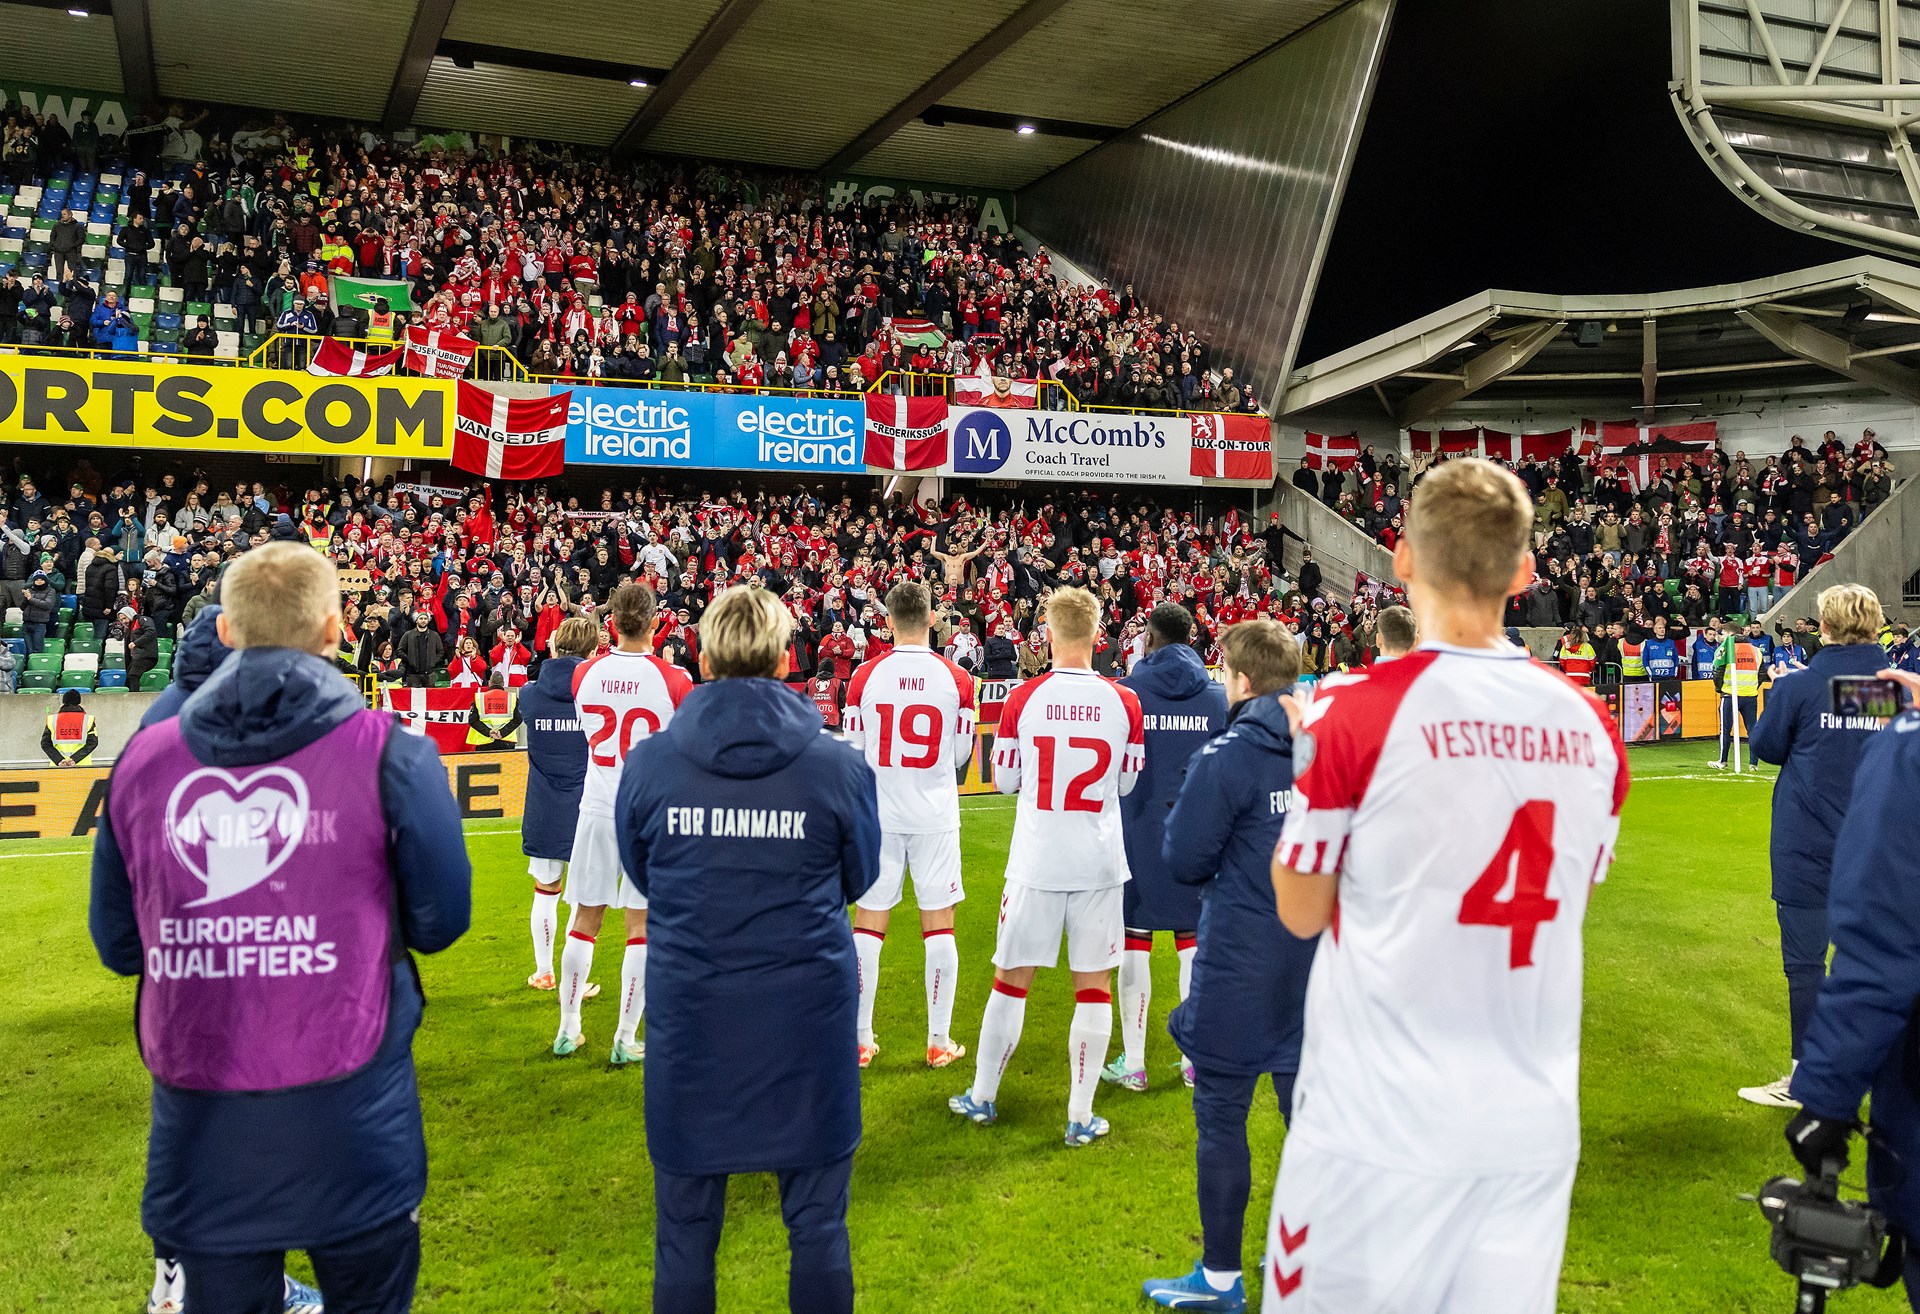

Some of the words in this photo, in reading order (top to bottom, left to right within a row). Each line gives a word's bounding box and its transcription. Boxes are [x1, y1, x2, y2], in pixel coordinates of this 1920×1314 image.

[0, 88, 128, 138] WA
[0, 368, 443, 448] RTS.COM
[567, 397, 689, 427] electric
[737, 405, 854, 436] electric
[457, 416, 549, 444] VANGEDE
[585, 424, 690, 459] Ireland
[966, 427, 1001, 460] M
[1025, 417, 1166, 449] McComb's
[1191, 437, 1270, 451] LUX-ON-TOUR
[758, 432, 855, 465] Ireland
[1026, 451, 1066, 465] Coach
[1070, 452, 1110, 467] Travel
[441, 489, 463, 497] THOMA
[899, 677, 925, 691] WIND
[1655, 668, 1669, 676] 973
[601, 680, 640, 695] YURARY
[535, 719, 552, 731] FOR
[555, 719, 584, 732] DANMA
[1046, 704, 1101, 722] DOLBERG
[1143, 714, 1157, 730] OR
[1160, 715, 1209, 732] DANMARK
[1846, 716, 1885, 732] DANMA
[582, 704, 661, 768] 20
[876, 703, 943, 769] 19
[1421, 721, 1597, 769] VESTERGAARD
[1032, 736, 1112, 813] 12
[1270, 791, 1292, 814] FOR
[667, 807, 705, 836] FOR
[711, 808, 807, 839] DANMARK
[1458, 799, 1560, 970] 4
[159, 915, 317, 945] EUROPEAN
[148, 942, 338, 983] QUALIFIERS
